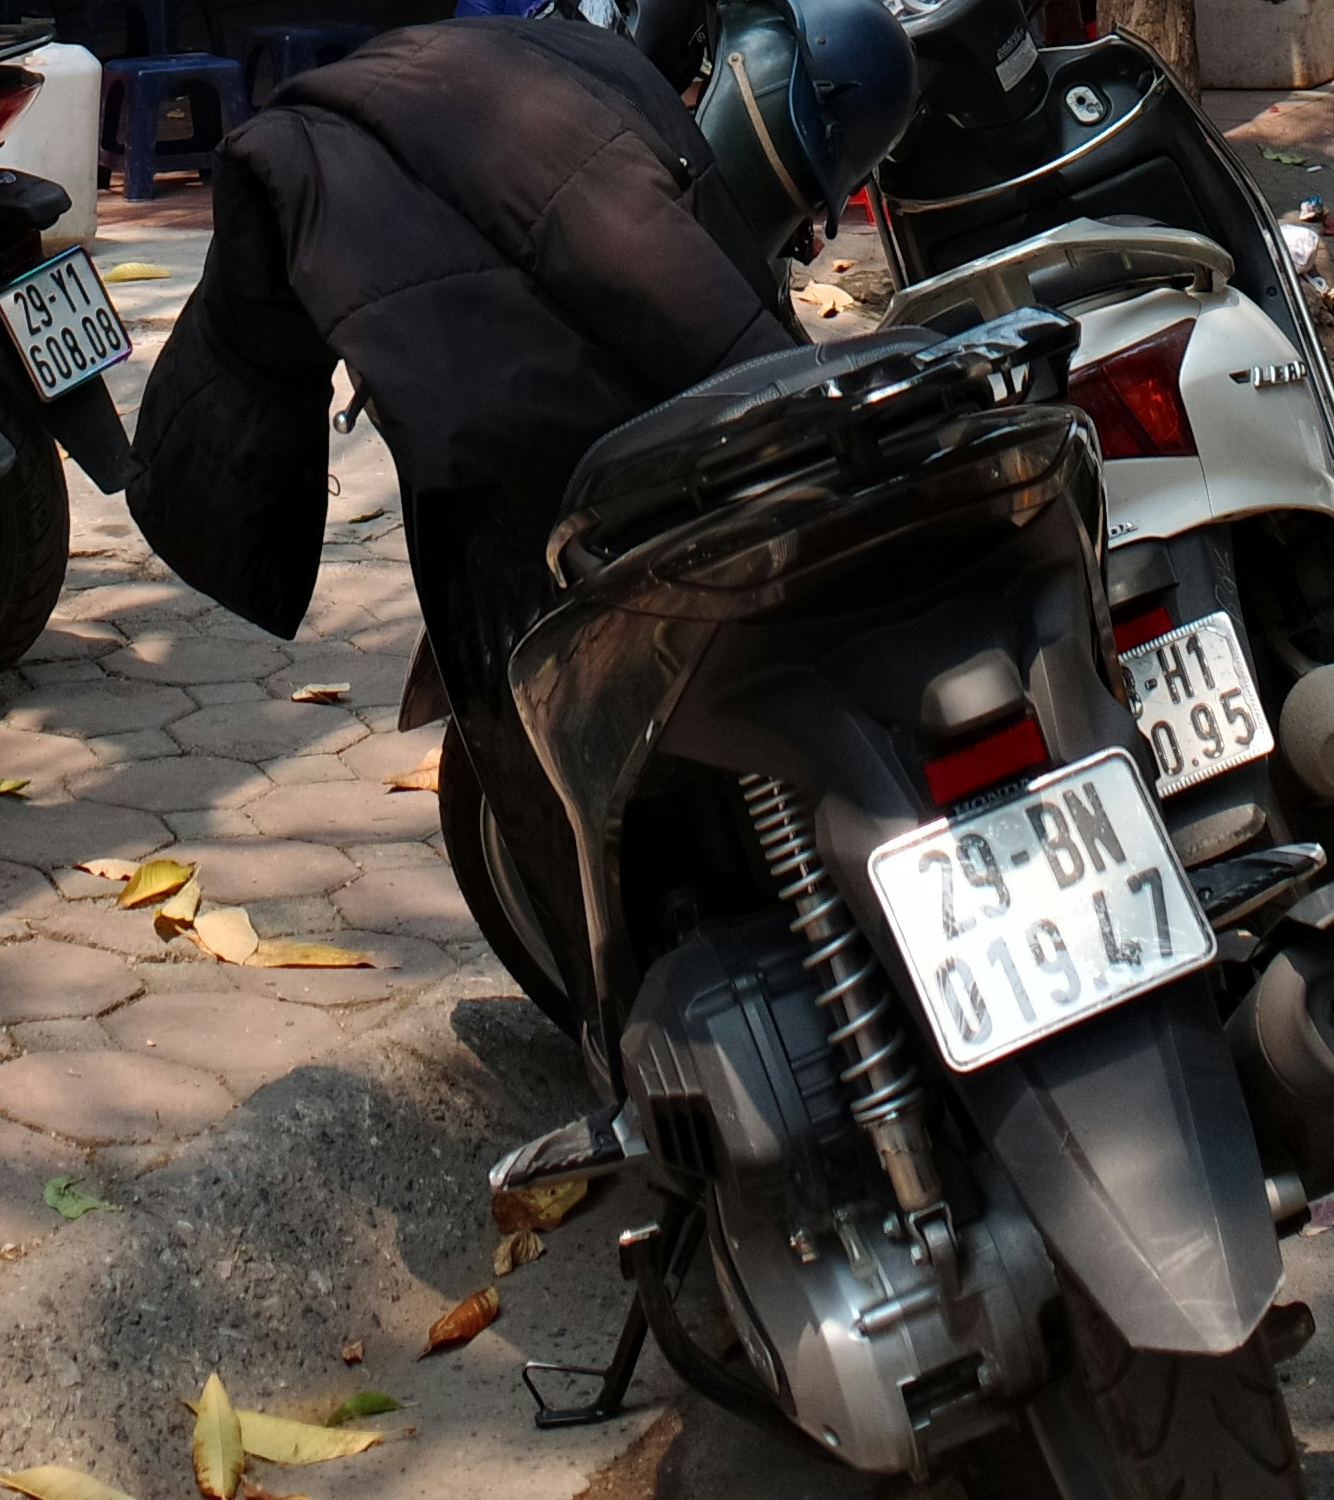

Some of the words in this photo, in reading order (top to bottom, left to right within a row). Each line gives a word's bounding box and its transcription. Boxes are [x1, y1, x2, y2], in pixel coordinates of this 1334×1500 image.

[13, 262, 92, 337] 29-Y1
[29, 307, 123, 389] 608.08
[917, 780, 1128, 943] 29-BN
[934, 866, 1175, 1045] 019.47
